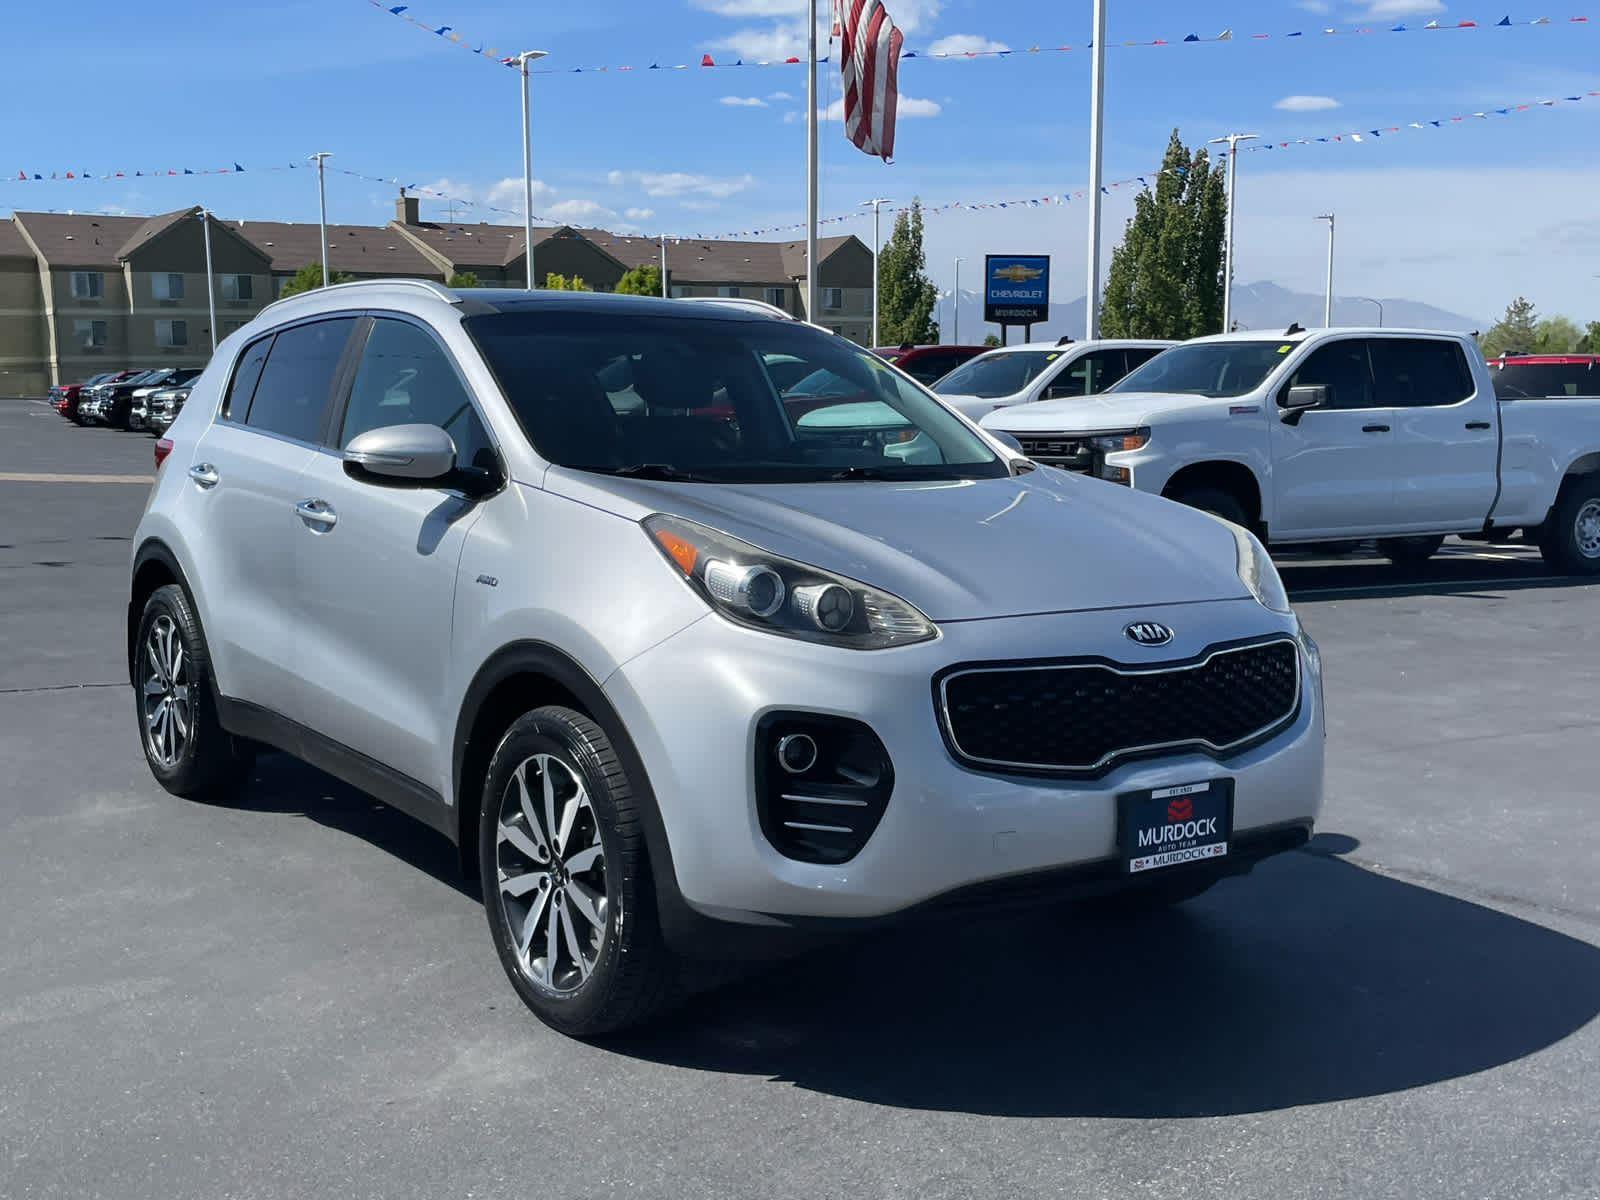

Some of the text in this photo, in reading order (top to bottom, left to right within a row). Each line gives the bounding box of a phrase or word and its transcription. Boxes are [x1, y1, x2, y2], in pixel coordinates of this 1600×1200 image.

[991, 290, 1042, 298] CHEVROLET
[1130, 624, 1168, 640] KIA
[1138, 817, 1217, 847] MURDOCK
[1158, 839, 1197, 852] AUTO TEAM
[1152, 847, 1206, 866] MURDOCK
